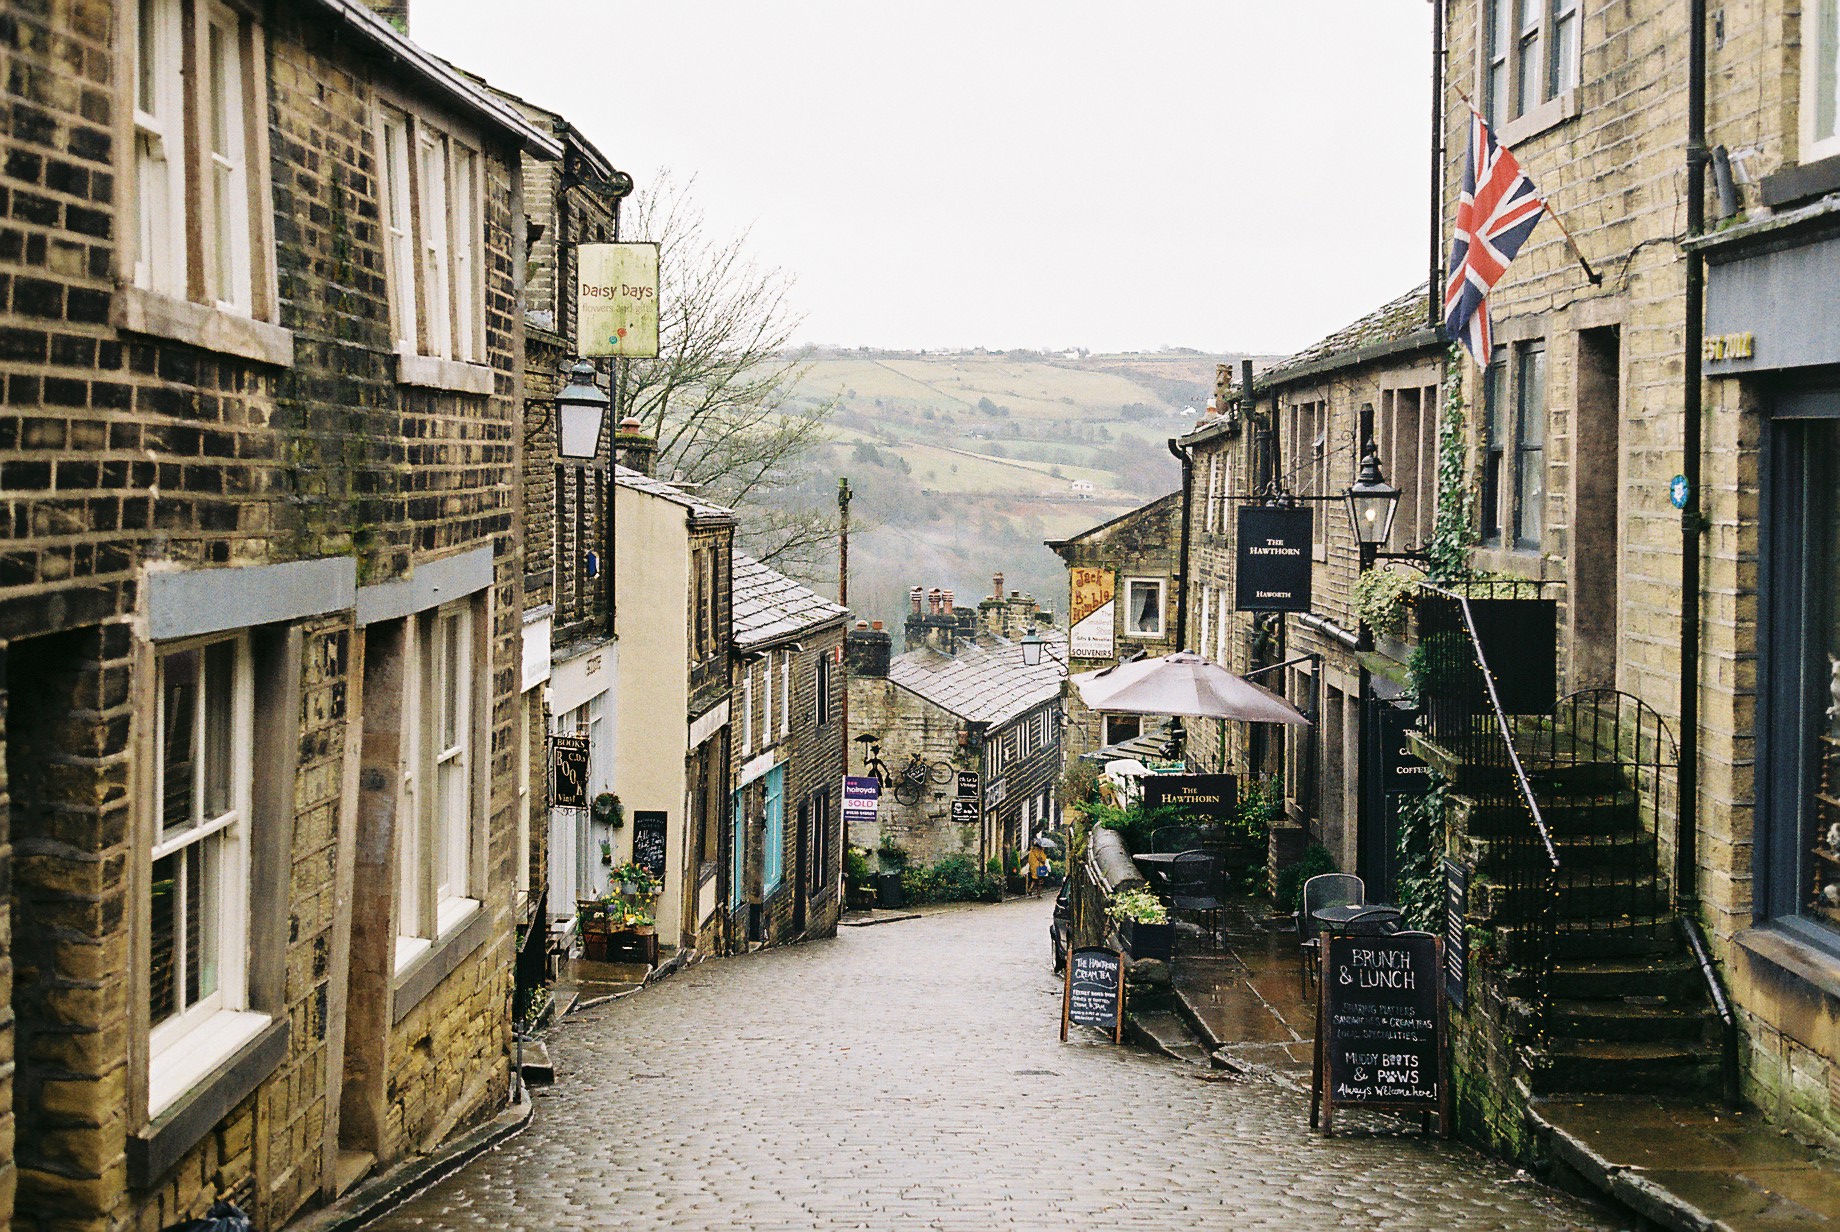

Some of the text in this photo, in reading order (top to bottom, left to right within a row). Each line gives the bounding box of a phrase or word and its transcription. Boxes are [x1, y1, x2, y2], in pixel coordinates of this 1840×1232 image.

[582, 284, 653, 300] Daisy Days
[582, 303, 613, 313] flowers
[1266, 538, 1284, 546] THE
[1249, 546, 1300, 556] HAWTHORN
[1075, 570, 1103, 588] Jack
[1256, 590, 1292, 599] HAWORTH
[1071, 648, 1112, 657] SOUVENIRS
[556, 738, 586, 749] BOOKS
[846, 785, 877, 795] holroyds
[1181, 786, 1198, 794] THE
[847, 799, 874, 808] SOLD
[1161, 793, 1220, 803] HAWTHORN
[1075, 957, 1088, 969] THE
[1352, 949, 1410, 969] BRUNCH
[1074, 968, 1112, 982] CREAM TEA
[1340, 965, 1415, 989] & LUNCH
[1389, 1017, 1415, 1029] CREAM
[1415, 1019, 1433, 1029] TEAS
[1345, 1052, 1378, 1066] MUDDY
[1353, 1066, 1369, 1081] &
[1337, 1082, 1373, 1101] Always
[1374, 1085, 1409, 1097] Welcome
